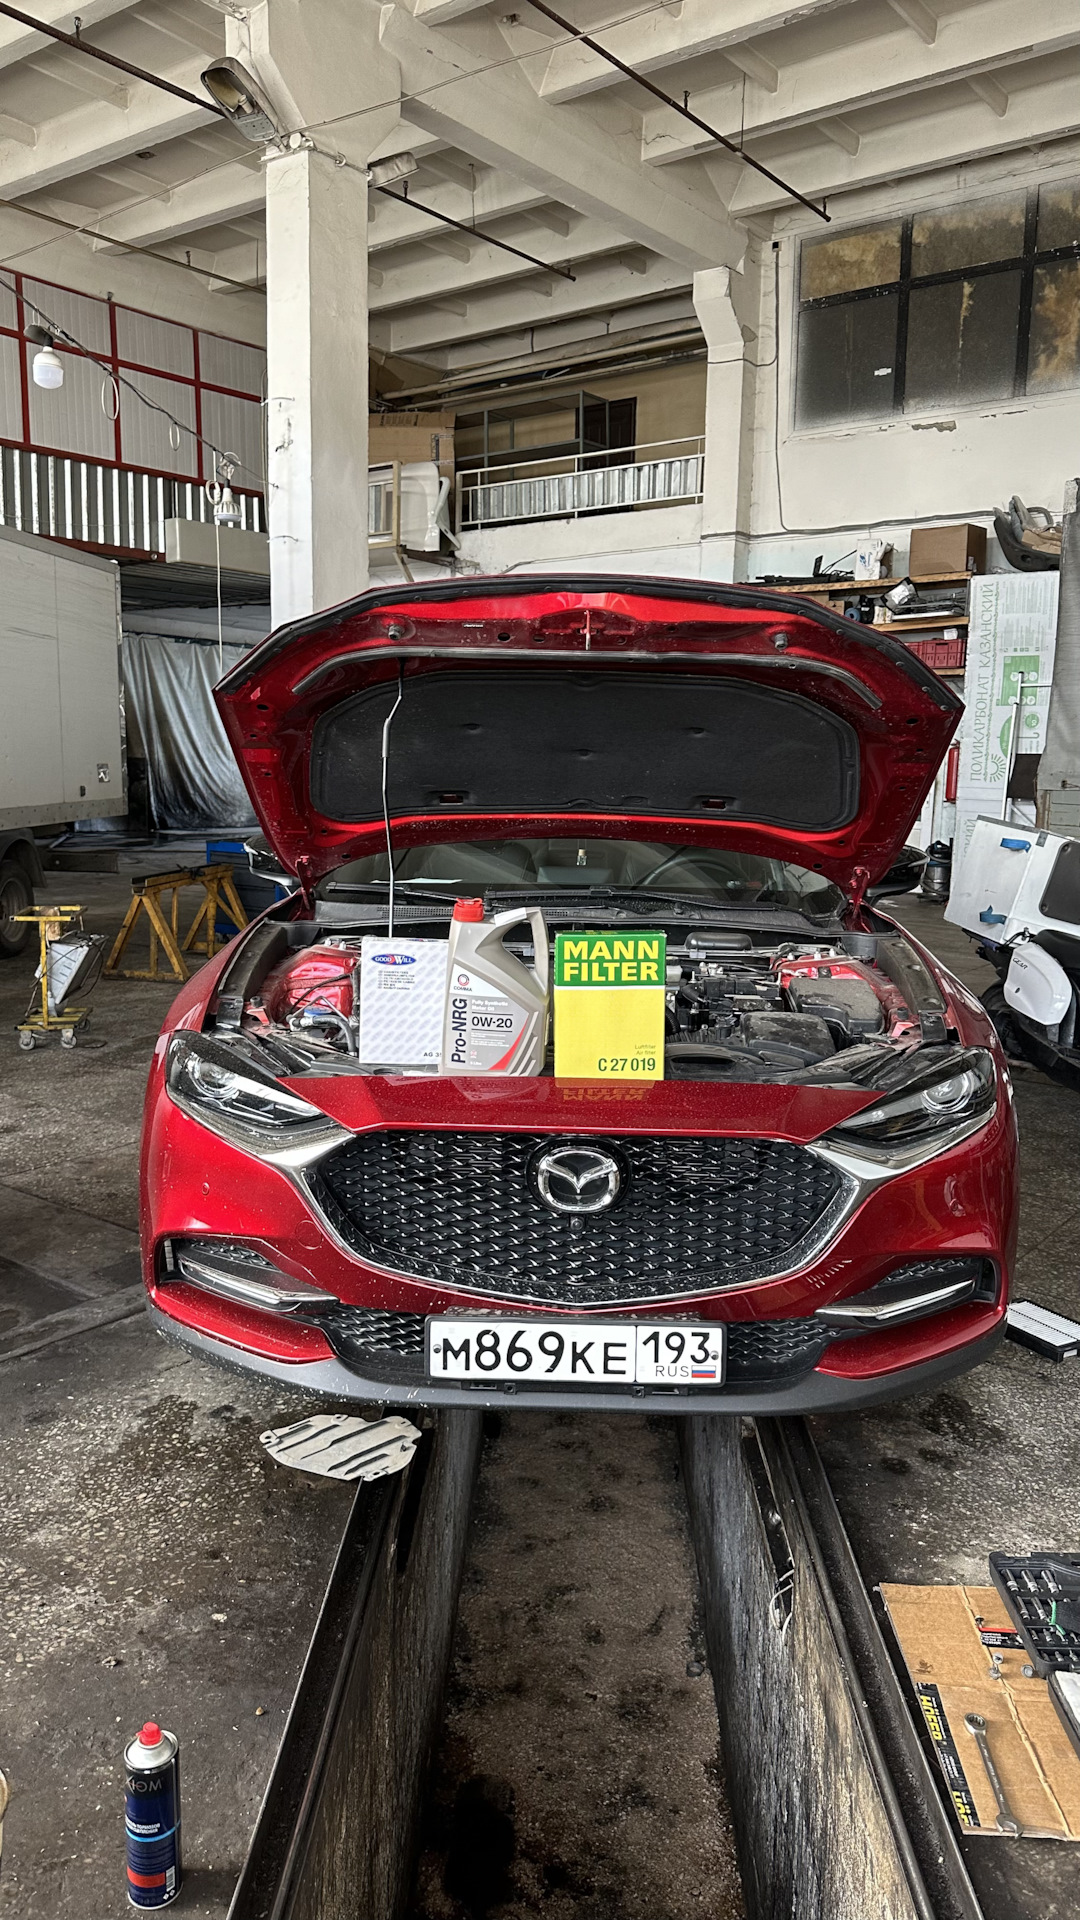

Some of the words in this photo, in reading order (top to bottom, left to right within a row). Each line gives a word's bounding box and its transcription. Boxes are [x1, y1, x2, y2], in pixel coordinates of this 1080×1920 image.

[979, 583, 994, 669] КАЗАНСКИЙ
[970, 674, 990, 782] ПОЛИКАРБОНАТ
[563, 940, 659, 960] MANN
[563, 961, 659, 982] FILTER
[451, 998, 468, 1063] Pro-NRG
[472, 1016, 513, 1028] 0W-20
[598, 1057, 607, 1072] C
[610, 1057, 628, 1072] 27
[630, 1057, 656, 1072] 019
[642, 1331, 711, 1364] 193
[655, 1365, 690, 1377] RUS
